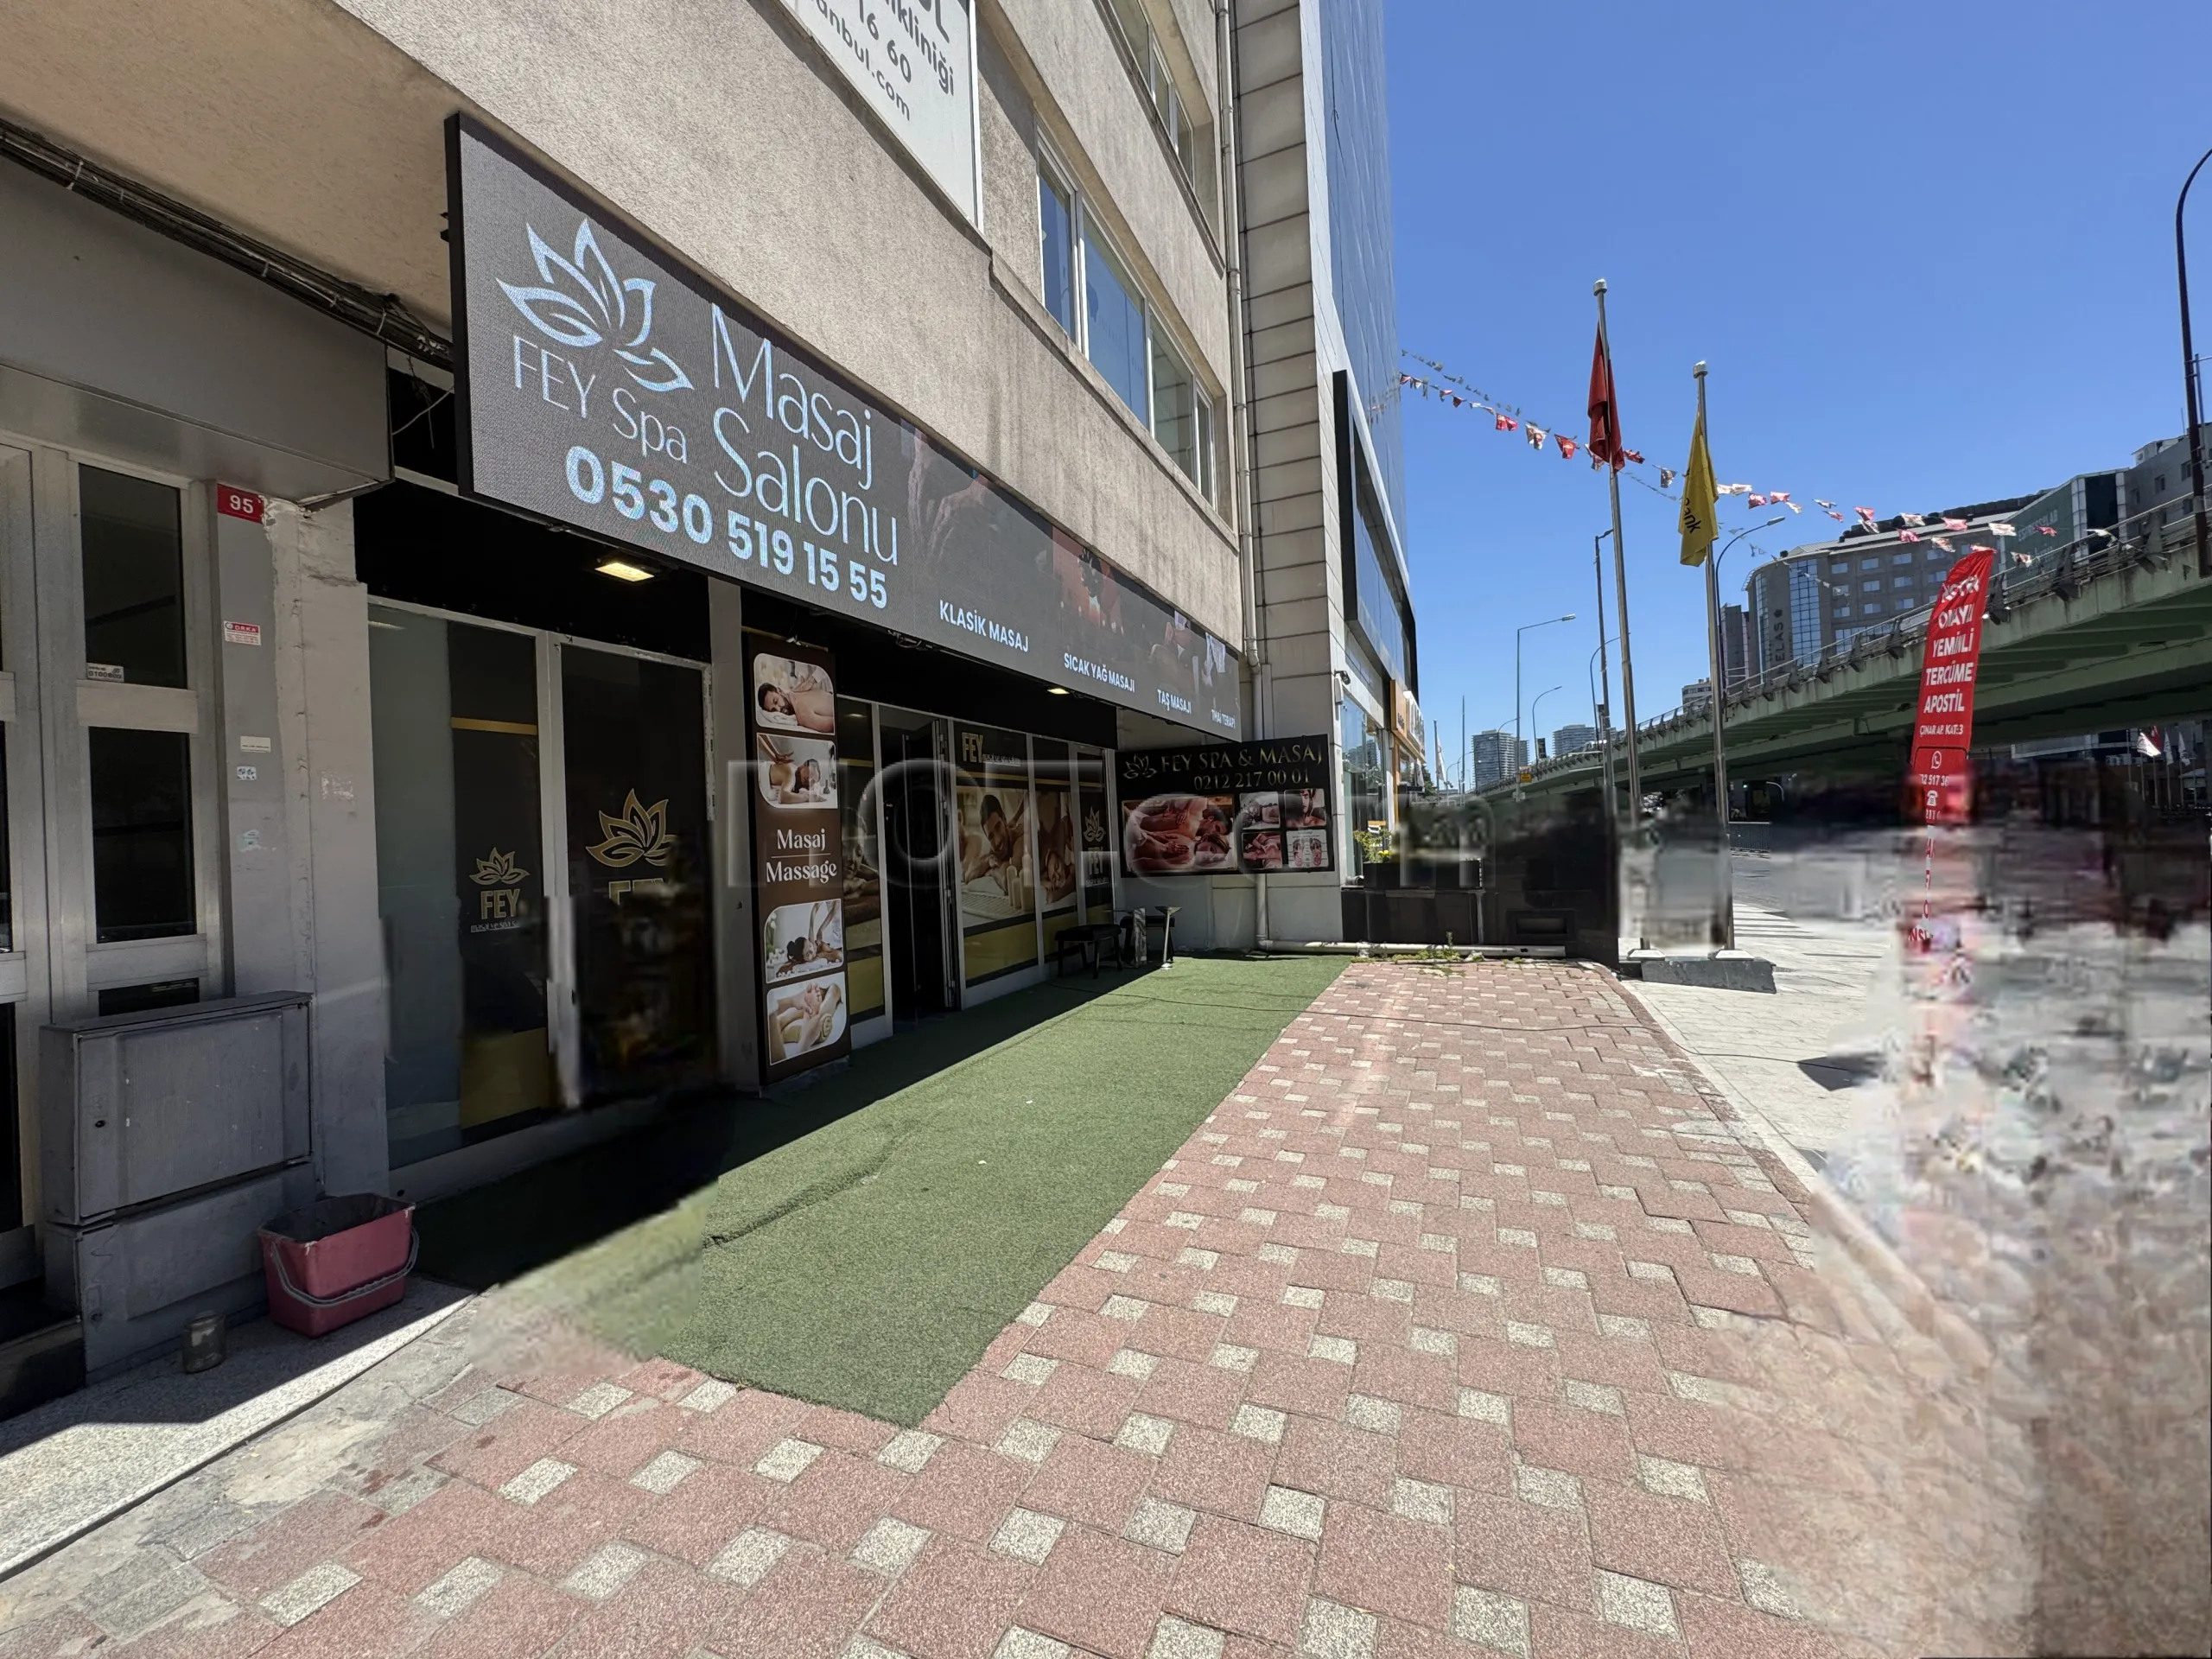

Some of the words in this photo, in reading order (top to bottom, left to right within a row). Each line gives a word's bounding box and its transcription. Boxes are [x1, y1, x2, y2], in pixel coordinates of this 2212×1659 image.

[812, 0, 910, 121] anbul.com
[887, 40, 912, 83] 60
[513, 335, 595, 417] FEY
[613, 388, 687, 464] Spa
[712, 303, 873, 489] Masaj
[714, 407, 898, 566] Salonu
[229, 495, 253, 513] 95
[566, 445, 712, 543] 0530
[728, 510, 794, 575] 519
[804, 541, 839, 591] 15
[849, 562, 888, 609] 55
[940, 600, 986, 637] KLASİK
[989, 620, 1028, 652] MASAJ
[1064, 652, 1089, 677] SICAK
[1090, 660, 1108, 683] YAĞ
[1109, 671, 1135, 693] MASAJI
[1157, 690, 1170, 711] TAŞ
[1923, 689, 1964, 714] APOSTİL
[962, 732, 983, 764] FEY
[1161, 753, 1192, 772] FEY
[1199, 752, 1233, 769] SPA
[1238, 748, 1252, 766] &
[1259, 744, 1322, 766] MASAJ
[1194, 774, 1230, 791] 0212
[1235, 771, 1262, 788] 217
[1268, 770, 1287, 785] 00
[1292, 769, 1310, 784] 01
[777, 828, 825, 851] Masaj
[766, 860, 837, 884] Massage
[480, 888, 520, 919] FEY
